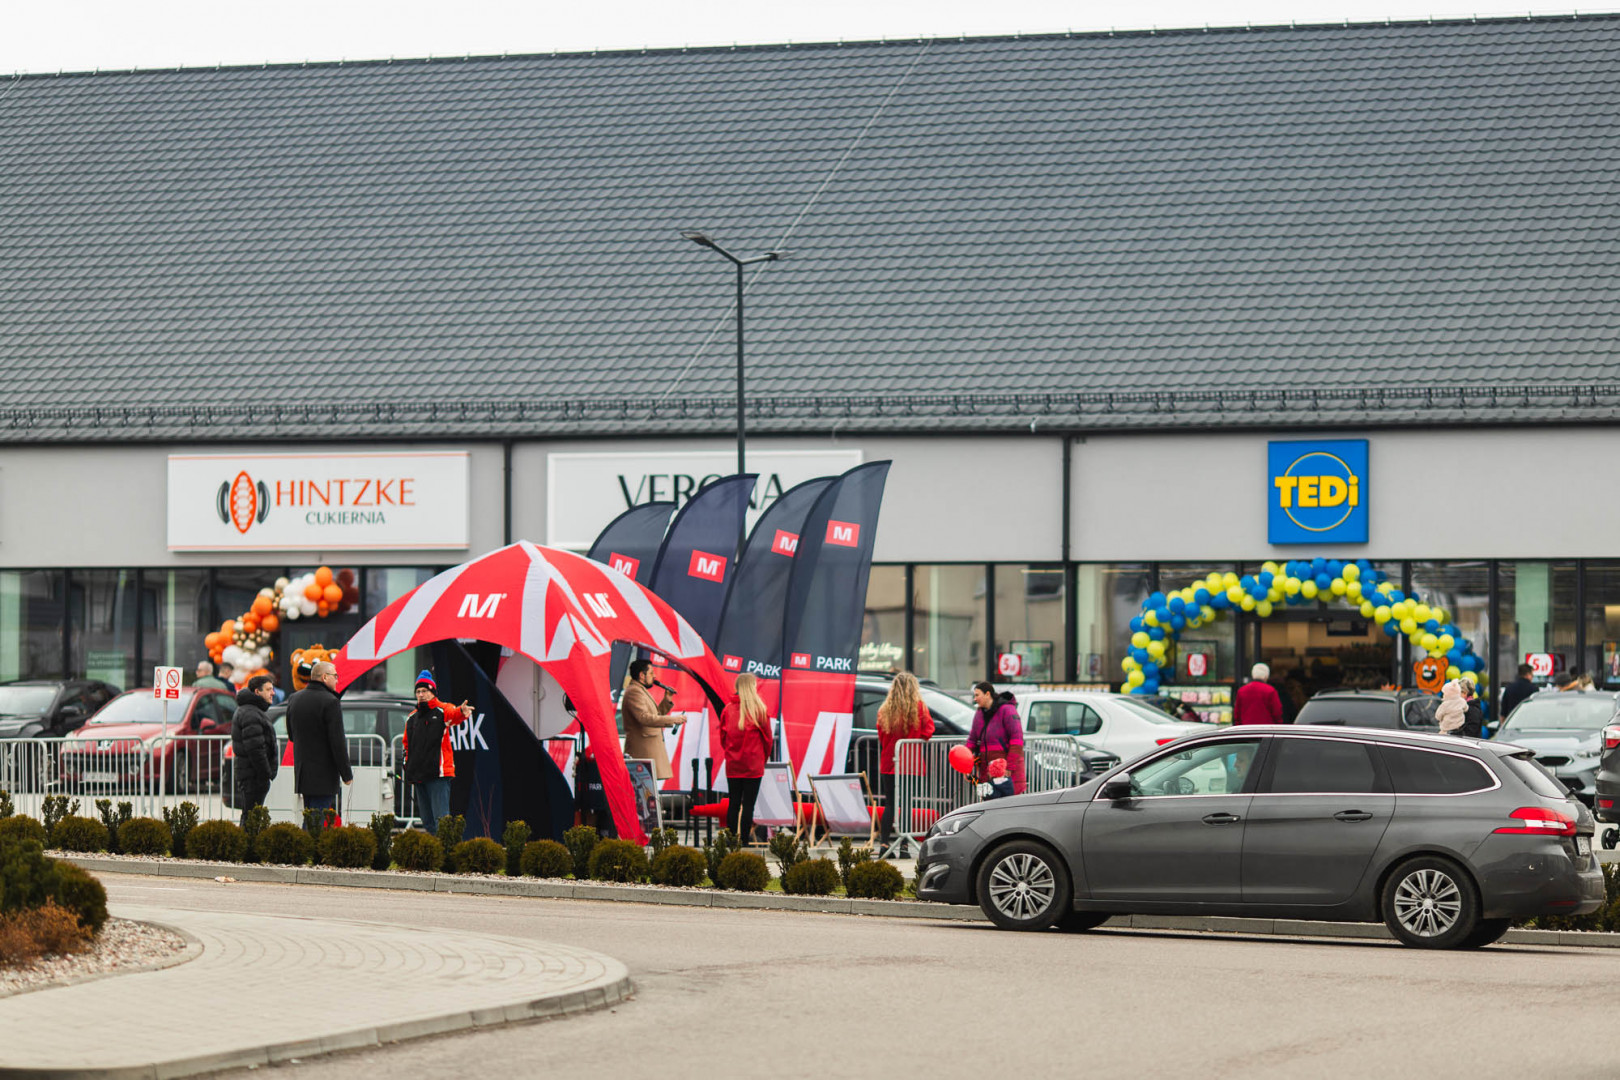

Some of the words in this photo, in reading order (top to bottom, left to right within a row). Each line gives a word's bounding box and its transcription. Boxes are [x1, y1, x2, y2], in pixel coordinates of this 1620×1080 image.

[276, 478, 415, 507] HINTZKE
[617, 473, 784, 510] VERA
[1274, 475, 1359, 508] TEDi
[305, 511, 386, 525] CUKIERNIA
[833, 526, 852, 541] M
[779, 536, 798, 552] M
[697, 557, 718, 576] M
[746, 660, 782, 677] PARK
[816, 656, 852, 671] PARK
[1532, 658, 1540, 671] 5
[449, 713, 489, 751] ARK
